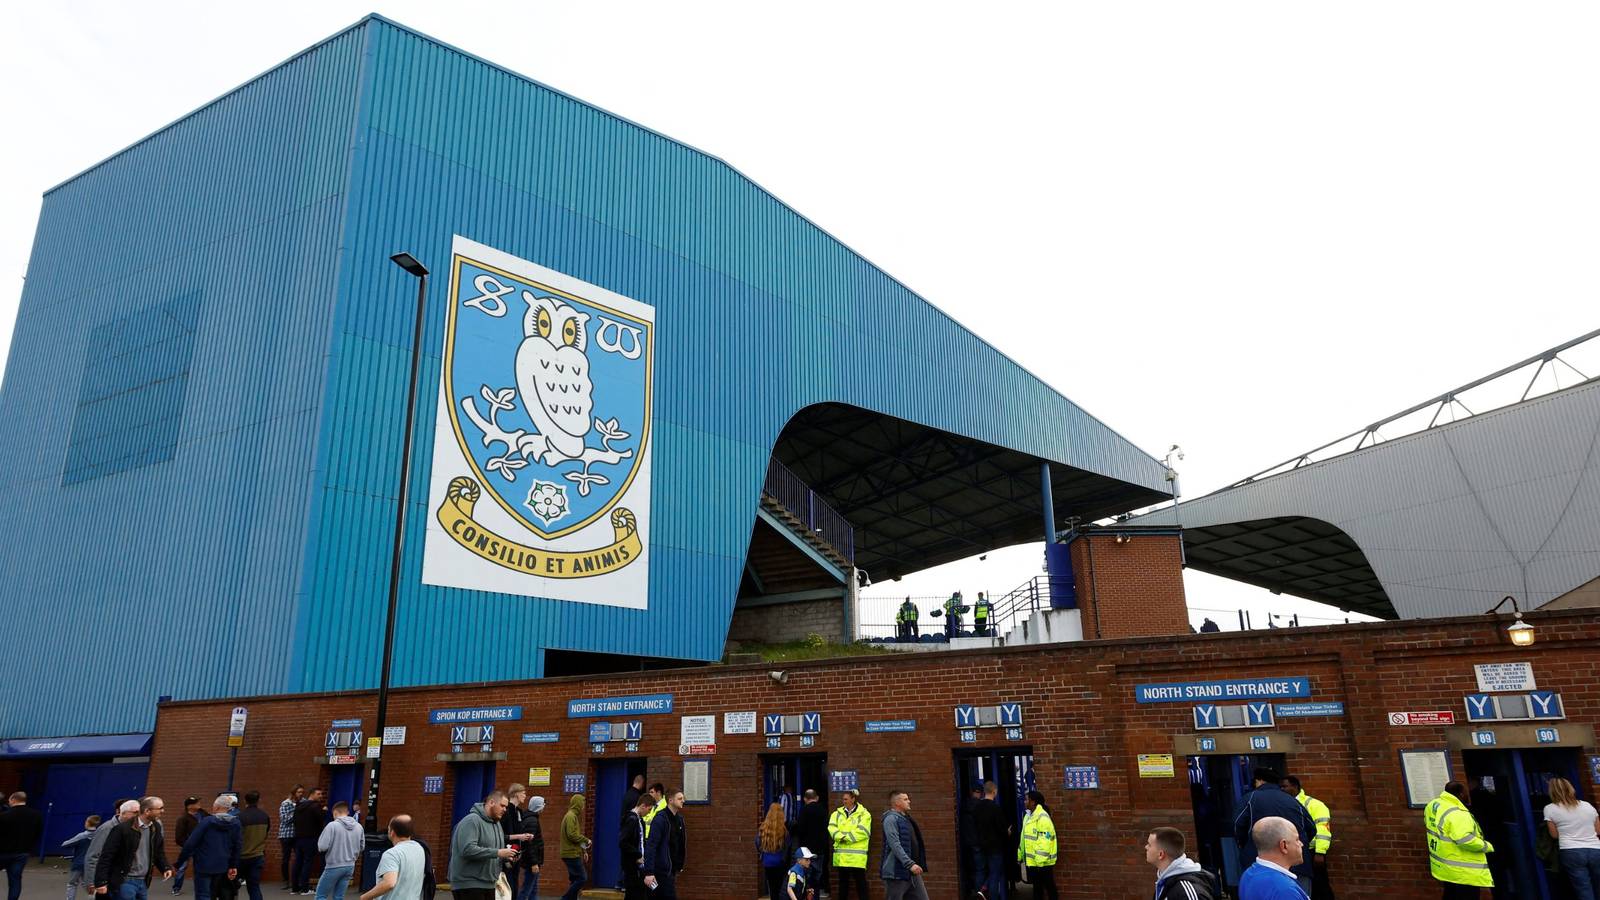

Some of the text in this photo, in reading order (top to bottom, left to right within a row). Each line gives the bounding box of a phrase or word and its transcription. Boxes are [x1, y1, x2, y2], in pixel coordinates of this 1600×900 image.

[451, 519, 630, 573] CONSILIO ET ANIMIS
[1143, 682, 1301, 699] NORTH STAND ENTRANCE Y
[571, 699, 671, 713] NORTH STAND ENTRANCE Y
[1469, 696, 1488, 715] Y
[1532, 694, 1552, 713] Y
[436, 708, 513, 721] SPION KOP ENTRANCE X
[959, 707, 972, 724] Y
[1002, 704, 1017, 721] Y
[1197, 706, 1213, 724] Y
[1249, 704, 1266, 722] Y
[768, 715, 779, 731] Y
[805, 714, 817, 730] Y
[455, 727, 464, 740] X
[482, 726, 491, 740] X
[629, 722, 639, 737] Y
[964, 731, 973, 740] 85
[1009, 729, 1018, 738] 86
[1541, 731, 1553, 741] 90
[328, 732, 337, 744] X
[352, 731, 360, 744] X
[1254, 738, 1266, 748] 88
[1480, 733, 1491, 743] 89
[1202, 740, 1212, 750] 87
